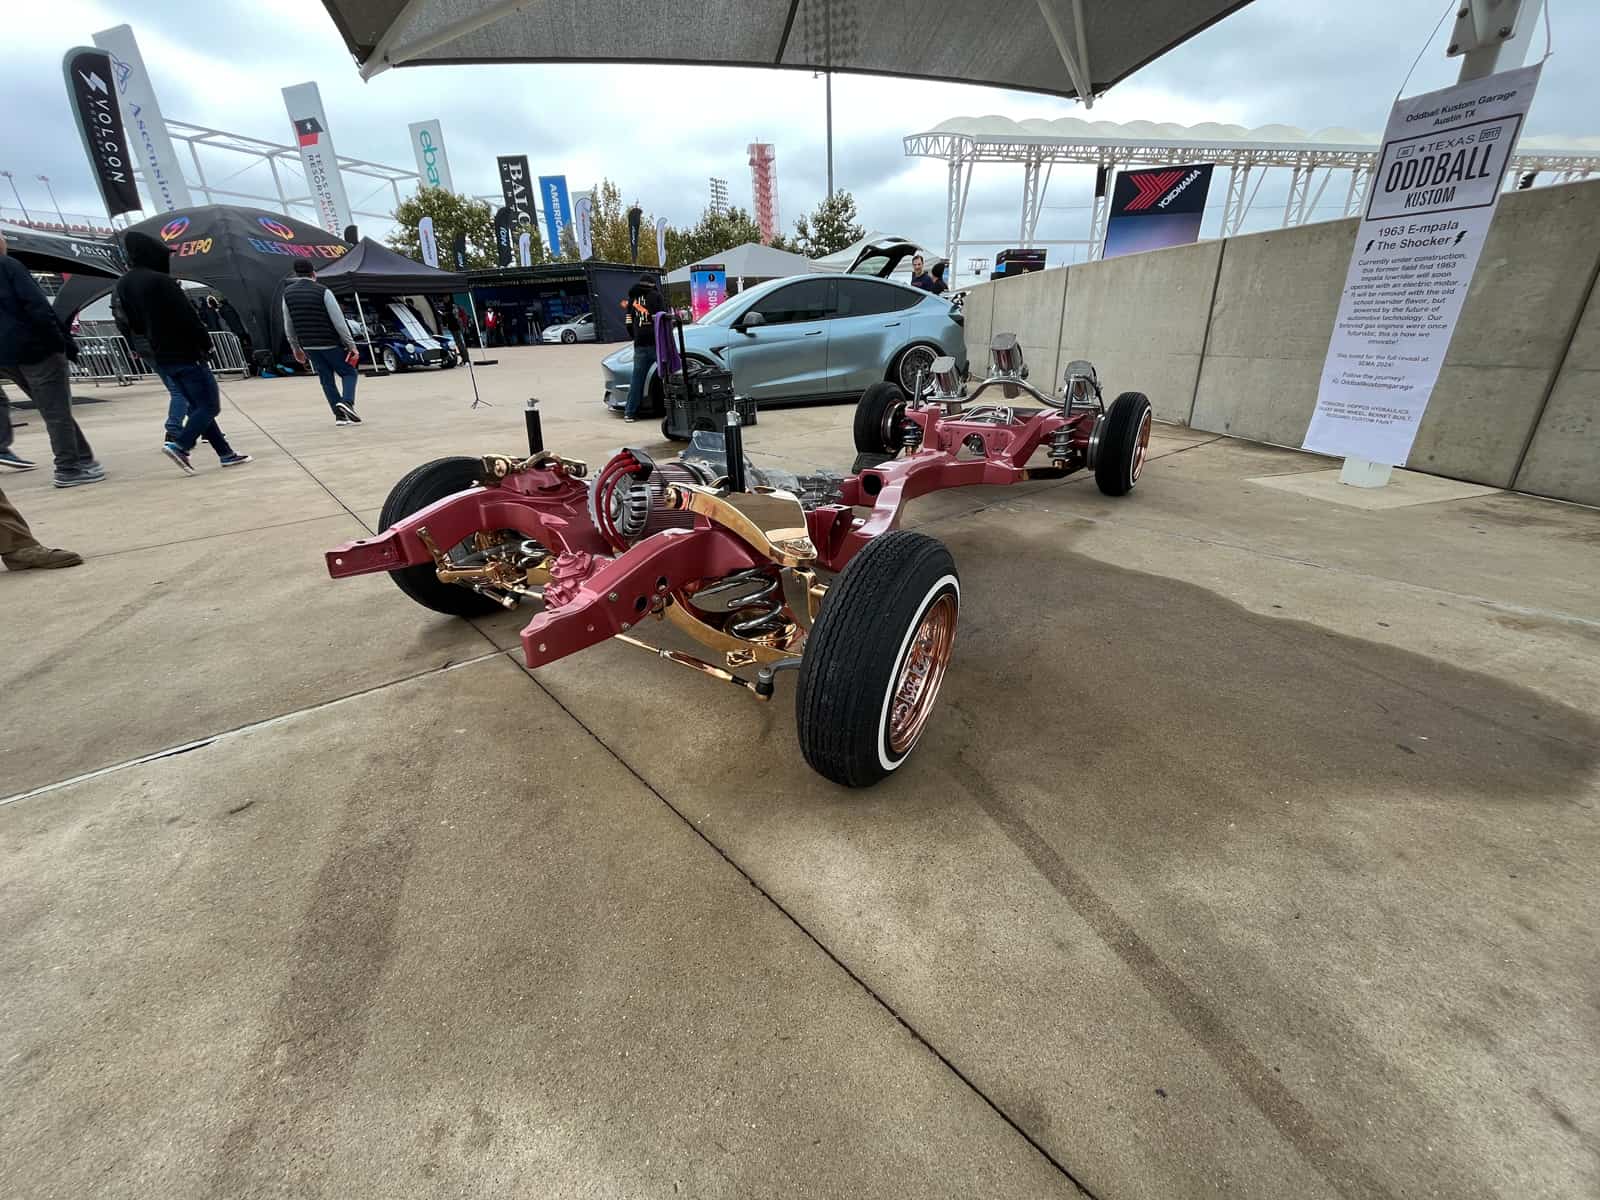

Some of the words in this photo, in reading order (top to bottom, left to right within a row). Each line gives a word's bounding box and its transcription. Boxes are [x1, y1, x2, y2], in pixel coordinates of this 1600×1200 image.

[1406, 108, 1439, 123] Oddball
[1441, 100, 1476, 113] Kustom
[1478, 90, 1517, 105] Garage
[1433, 113, 1462, 126] Austin
[1464, 109, 1476, 118] TX
[95, 99, 127, 184] VOLCON
[1428, 134, 1476, 152] TEXAS
[129, 103, 176, 212] Ascension
[420, 129, 440, 187] eba
[1385, 143, 1493, 193] ODDBALL
[1157, 169, 1201, 209] YOKOHAMA
[1404, 186, 1456, 208] KUSTOM
[1379, 226, 1405, 237] 1963
[1407, 220, 1460, 235] E-mpala
[179, 238, 213, 257] EXPO
[1377, 240, 1396, 250] The
[1399, 236, 1452, 249] Shocker
